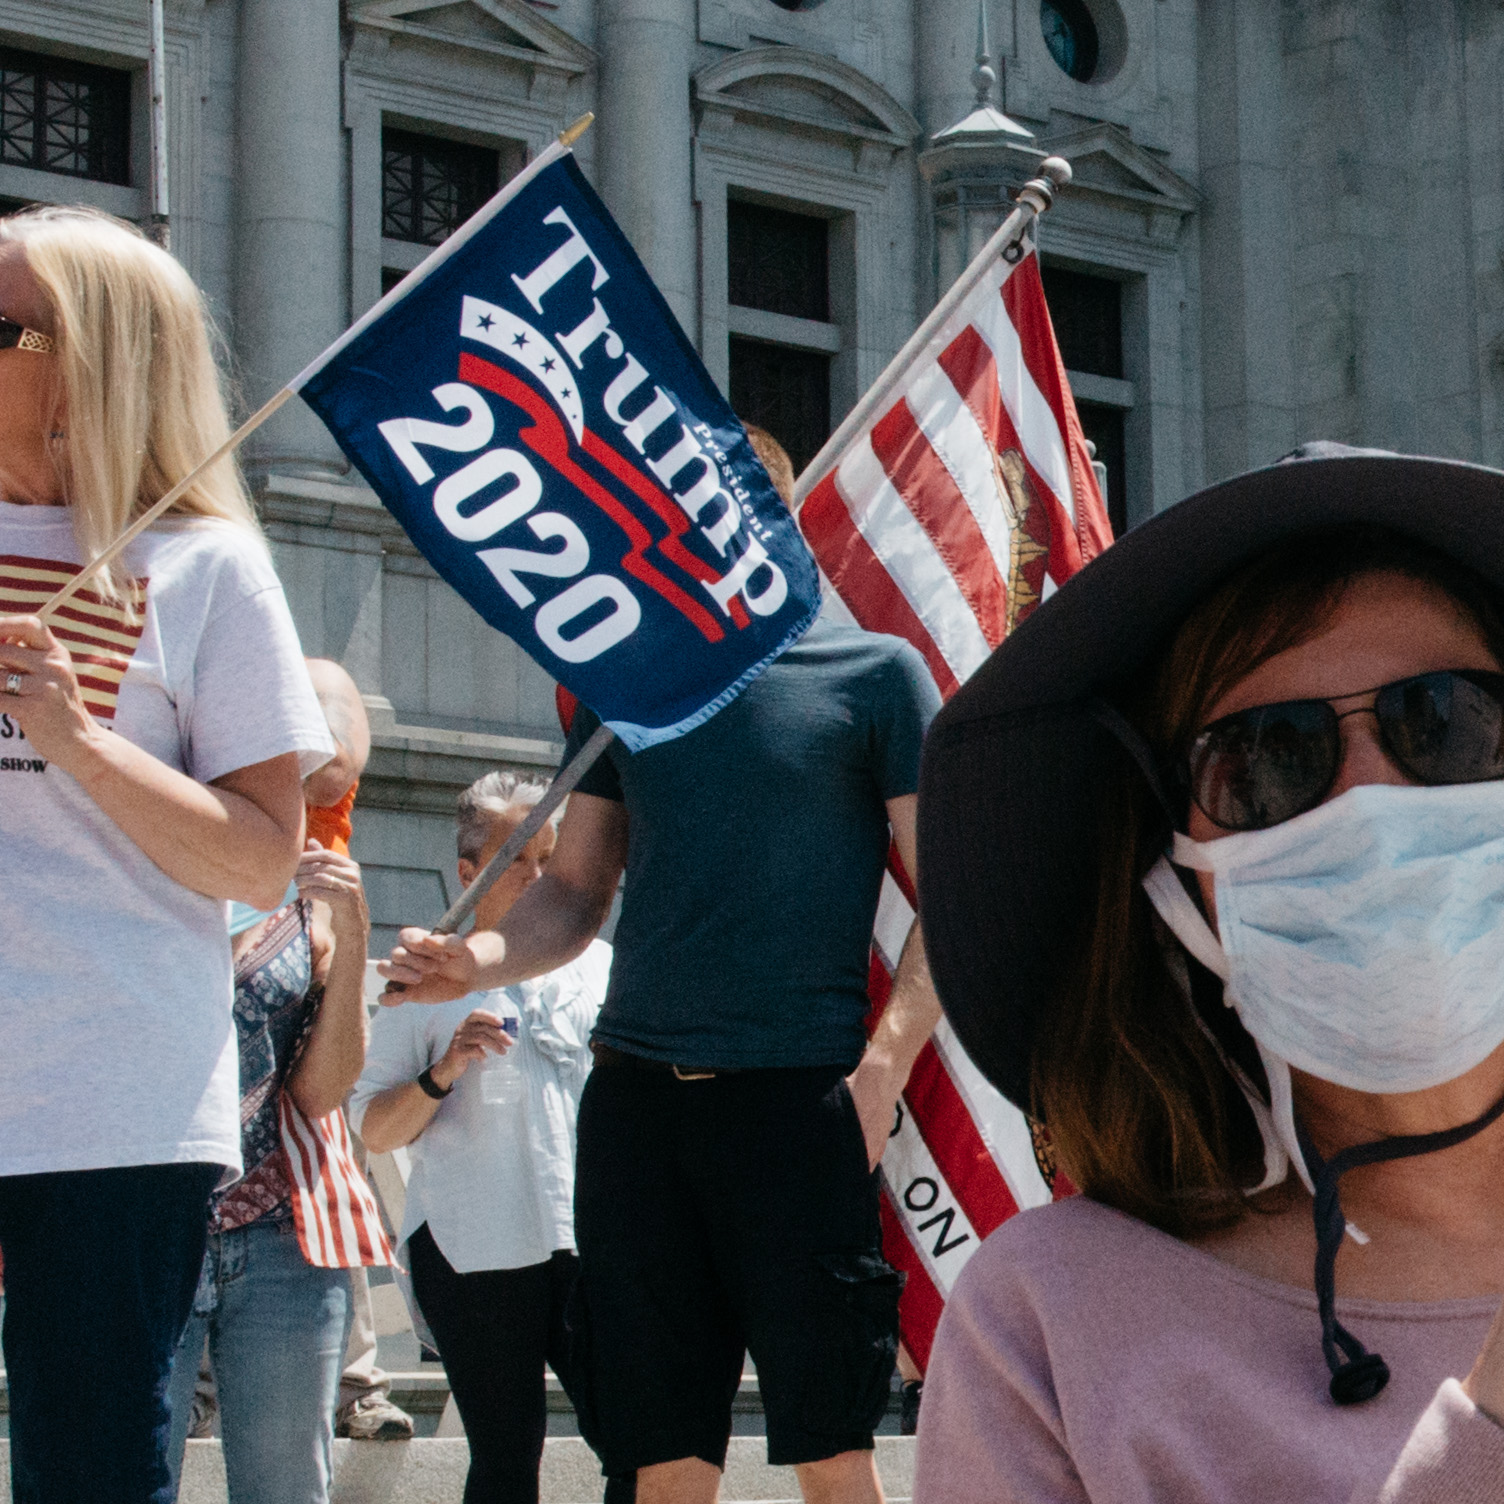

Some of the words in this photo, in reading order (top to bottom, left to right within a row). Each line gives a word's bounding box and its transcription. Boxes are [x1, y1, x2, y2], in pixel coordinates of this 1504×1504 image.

[510, 204, 790, 618] Trump
[692, 421, 774, 543] President
[376, 381, 643, 665] 2020
[903, 1176, 971, 1259] ON
